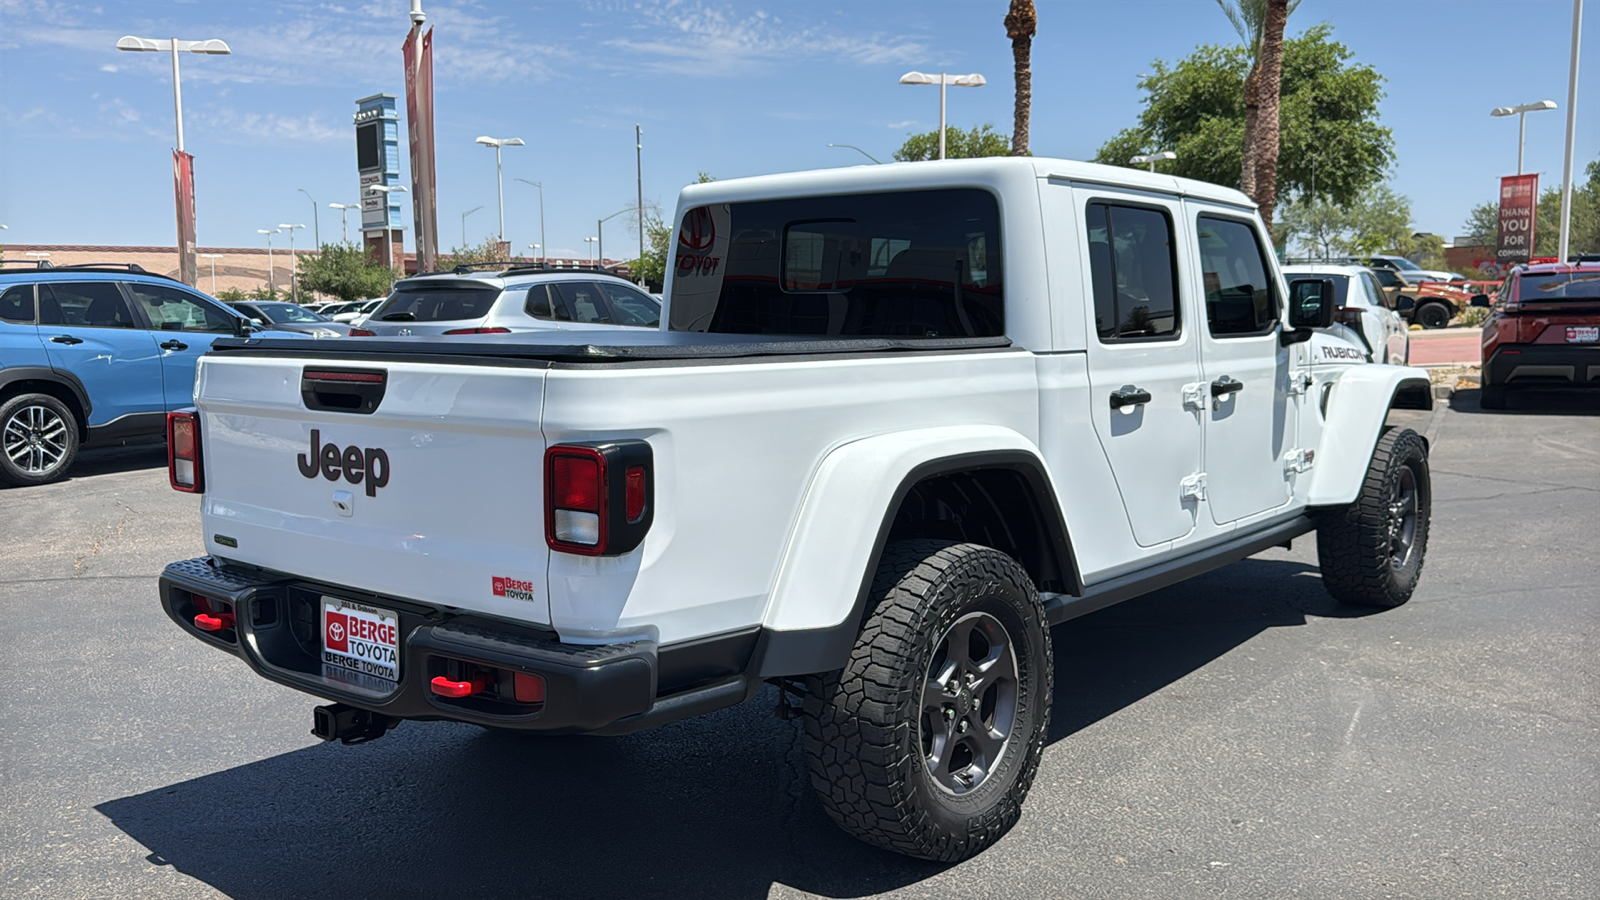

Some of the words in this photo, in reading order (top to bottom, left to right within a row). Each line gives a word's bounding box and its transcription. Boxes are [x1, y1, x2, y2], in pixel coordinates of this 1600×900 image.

[1501, 208, 1531, 217] THANK
[1501, 219, 1530, 232] YOU
[1504, 235, 1525, 246] FOR
[1498, 249, 1529, 258] COMING!
[1321, 346, 1365, 360] RUBICON
[297, 429, 390, 497] Jeep
[505, 577, 534, 592] BERGE
[505, 589, 534, 601] TOYOTA
[357, 604, 378, 615] Dobson
[349, 615, 396, 646] BERGE
[349, 640, 397, 665] TOYOTA
[325, 651, 360, 669] BERGE
[362, 660, 395, 680] TOYOTA
